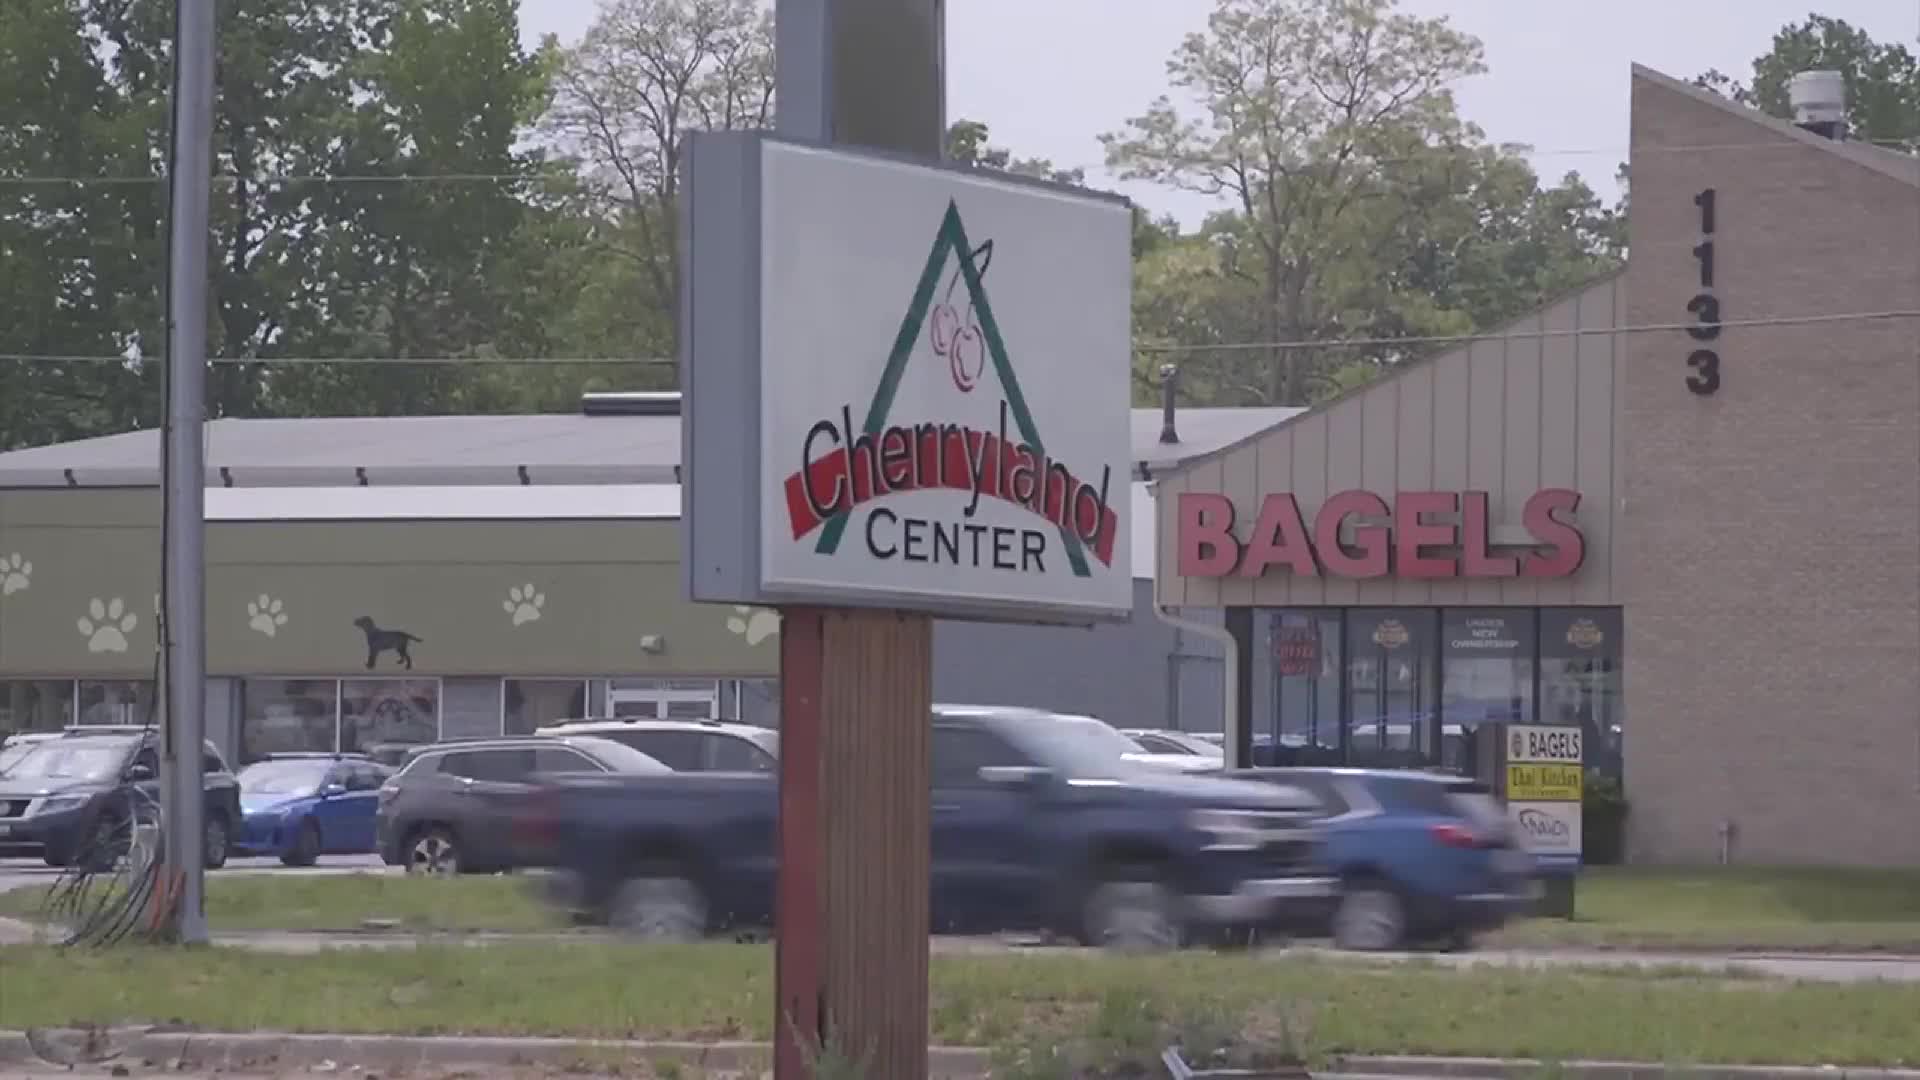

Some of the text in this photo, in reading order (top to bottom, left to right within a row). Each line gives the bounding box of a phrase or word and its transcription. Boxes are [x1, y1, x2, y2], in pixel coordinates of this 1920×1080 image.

[1686, 188, 1720, 395] 1133
[802, 399, 1111, 546] Cherryland
[866, 507, 1046, 572] CENTER
[1178, 488, 1586, 578] BAGELS
[1472, 629, 1498, 638] NEW
[1529, 732, 1579, 758] BAGELS
